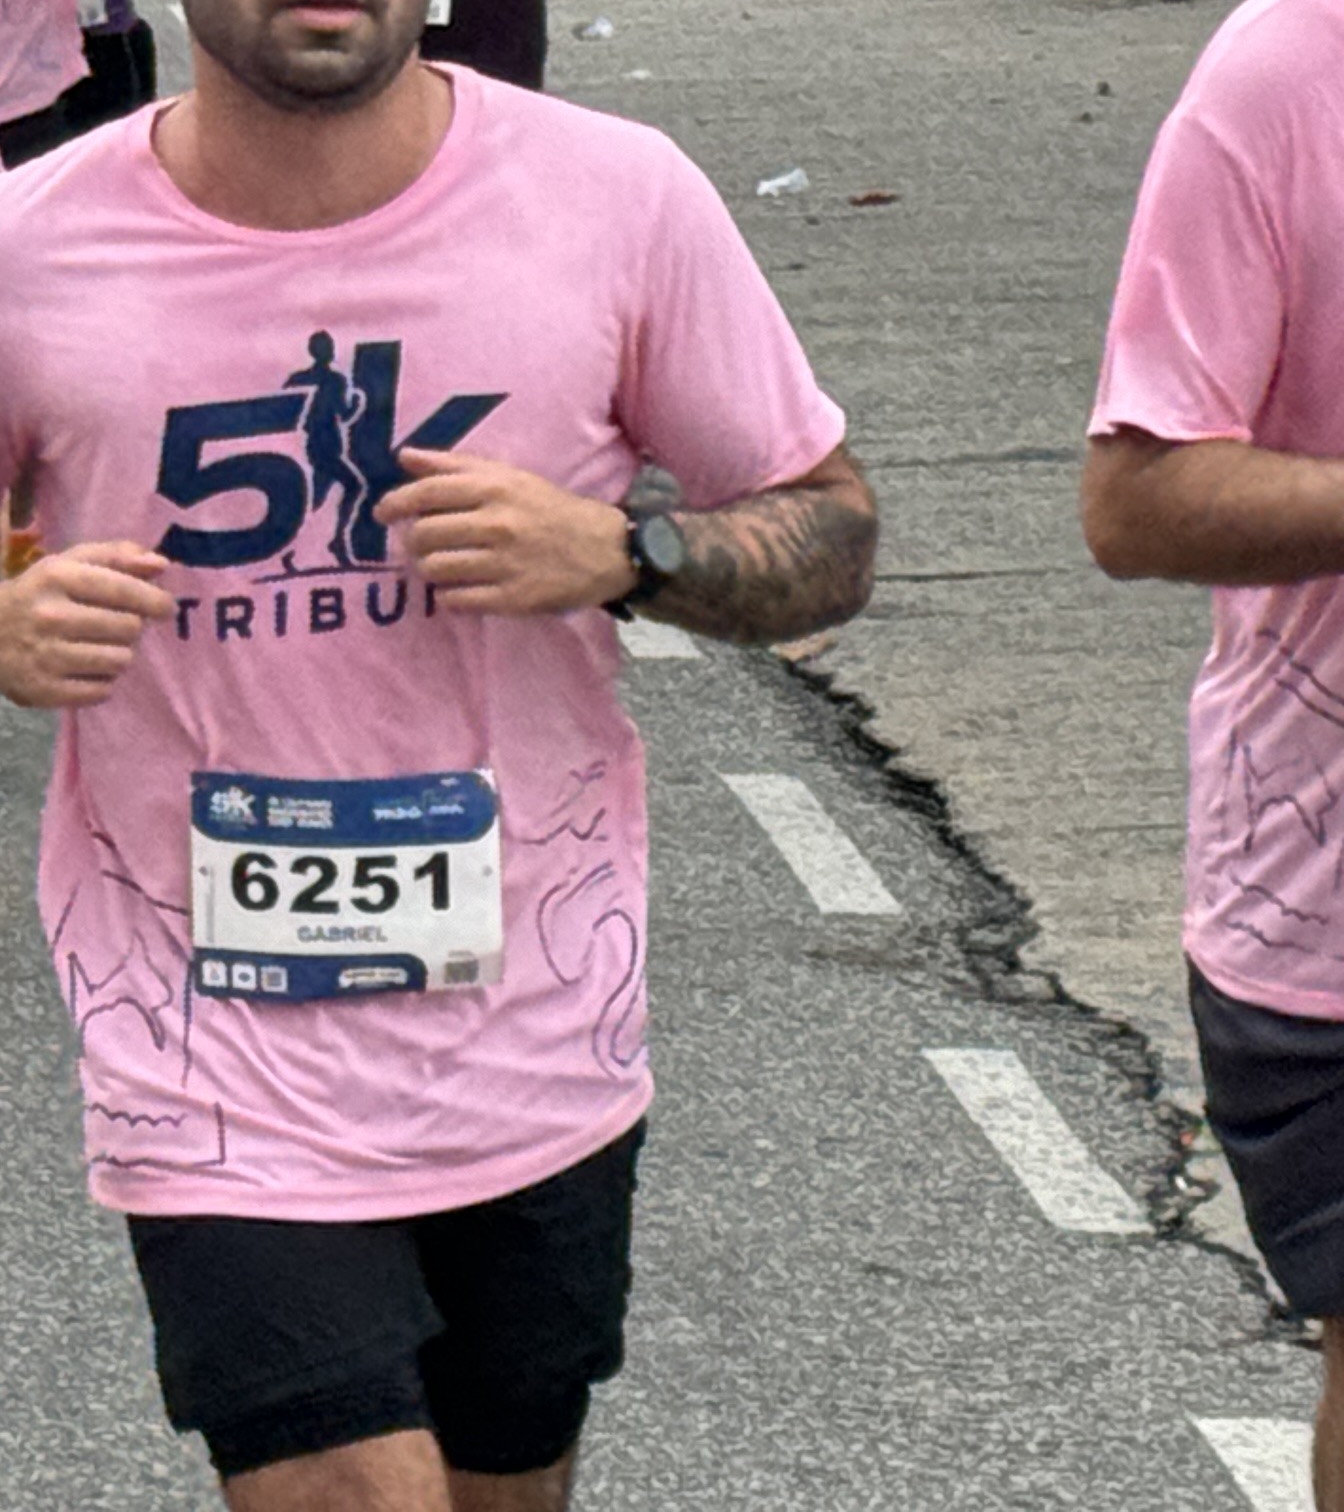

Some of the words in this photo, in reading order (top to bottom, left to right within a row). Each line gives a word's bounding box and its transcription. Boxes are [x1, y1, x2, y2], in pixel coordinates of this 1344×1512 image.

[172, 586, 439, 641] TRIBU
[231, 850, 451, 915] 6251
[297, 925, 389, 943] GABRIEL
